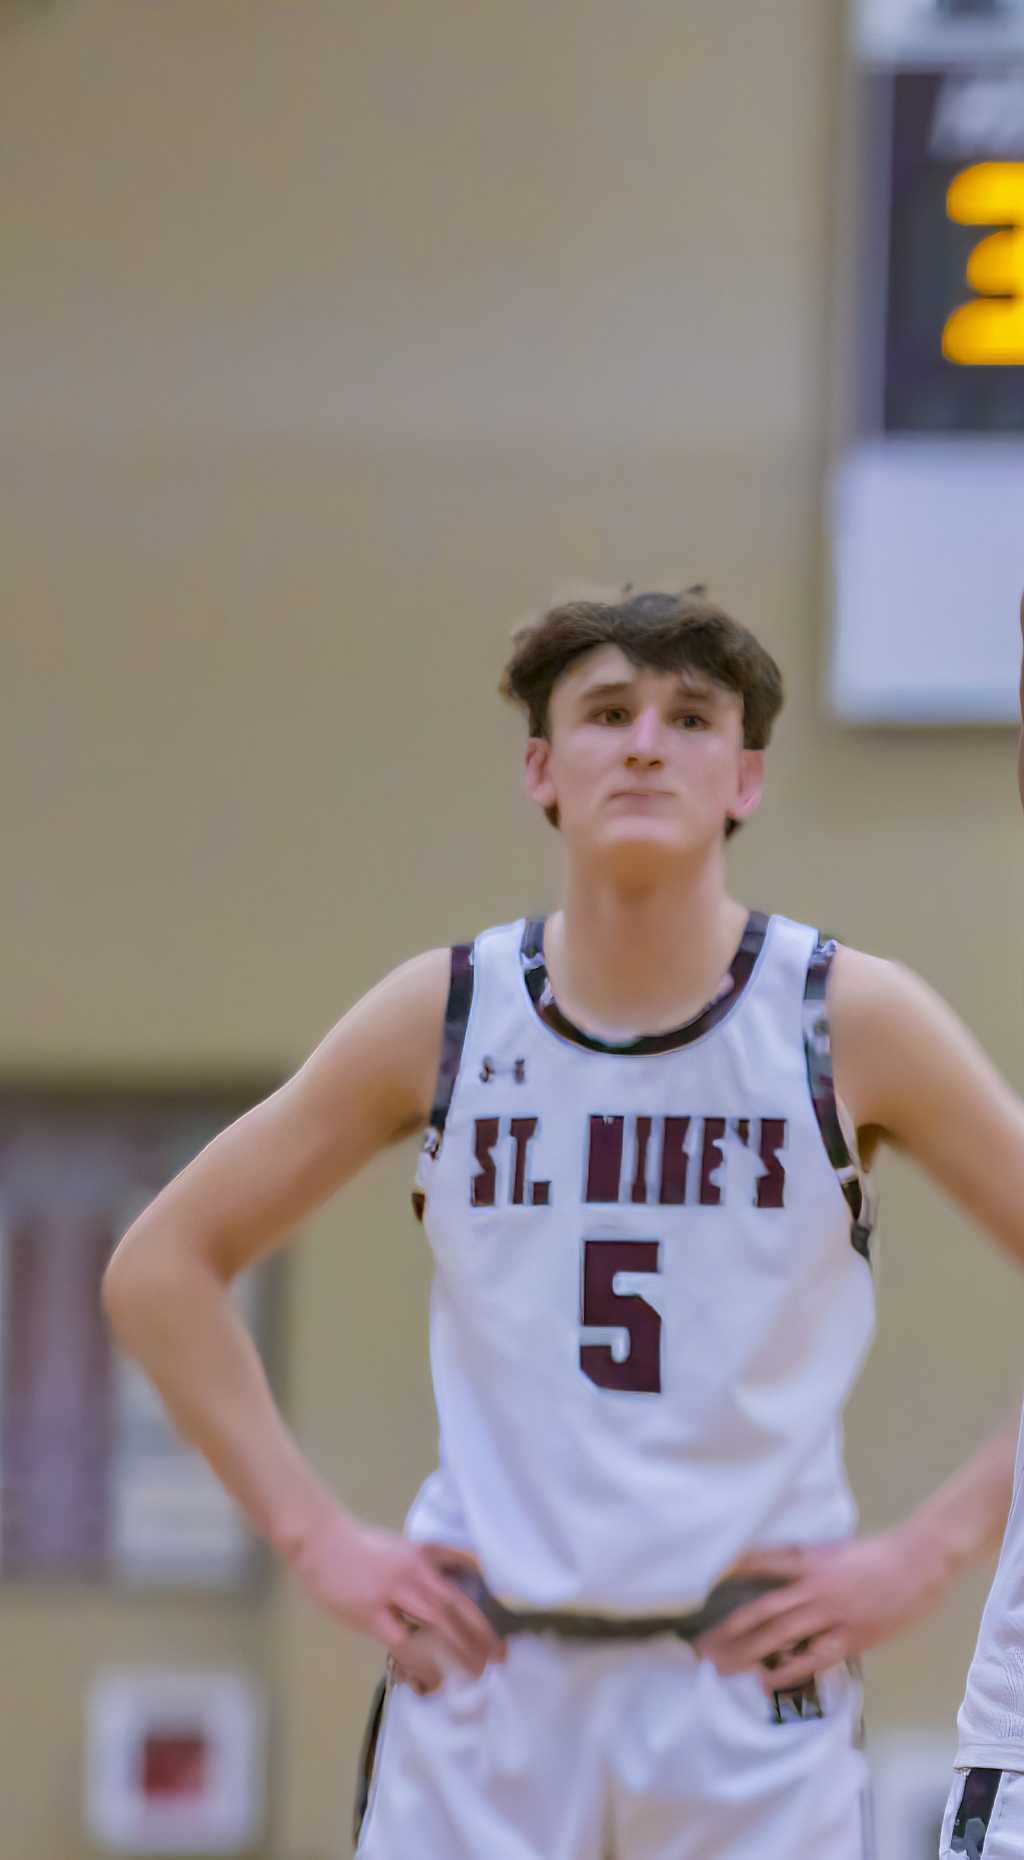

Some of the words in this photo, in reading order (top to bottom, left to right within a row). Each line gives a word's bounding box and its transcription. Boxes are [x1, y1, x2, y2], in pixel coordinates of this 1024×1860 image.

[470, 1115, 552, 1208] ST.
[583, 1113, 788, 1209] MIKE'S
[579, 1240, 662, 1394] 5
